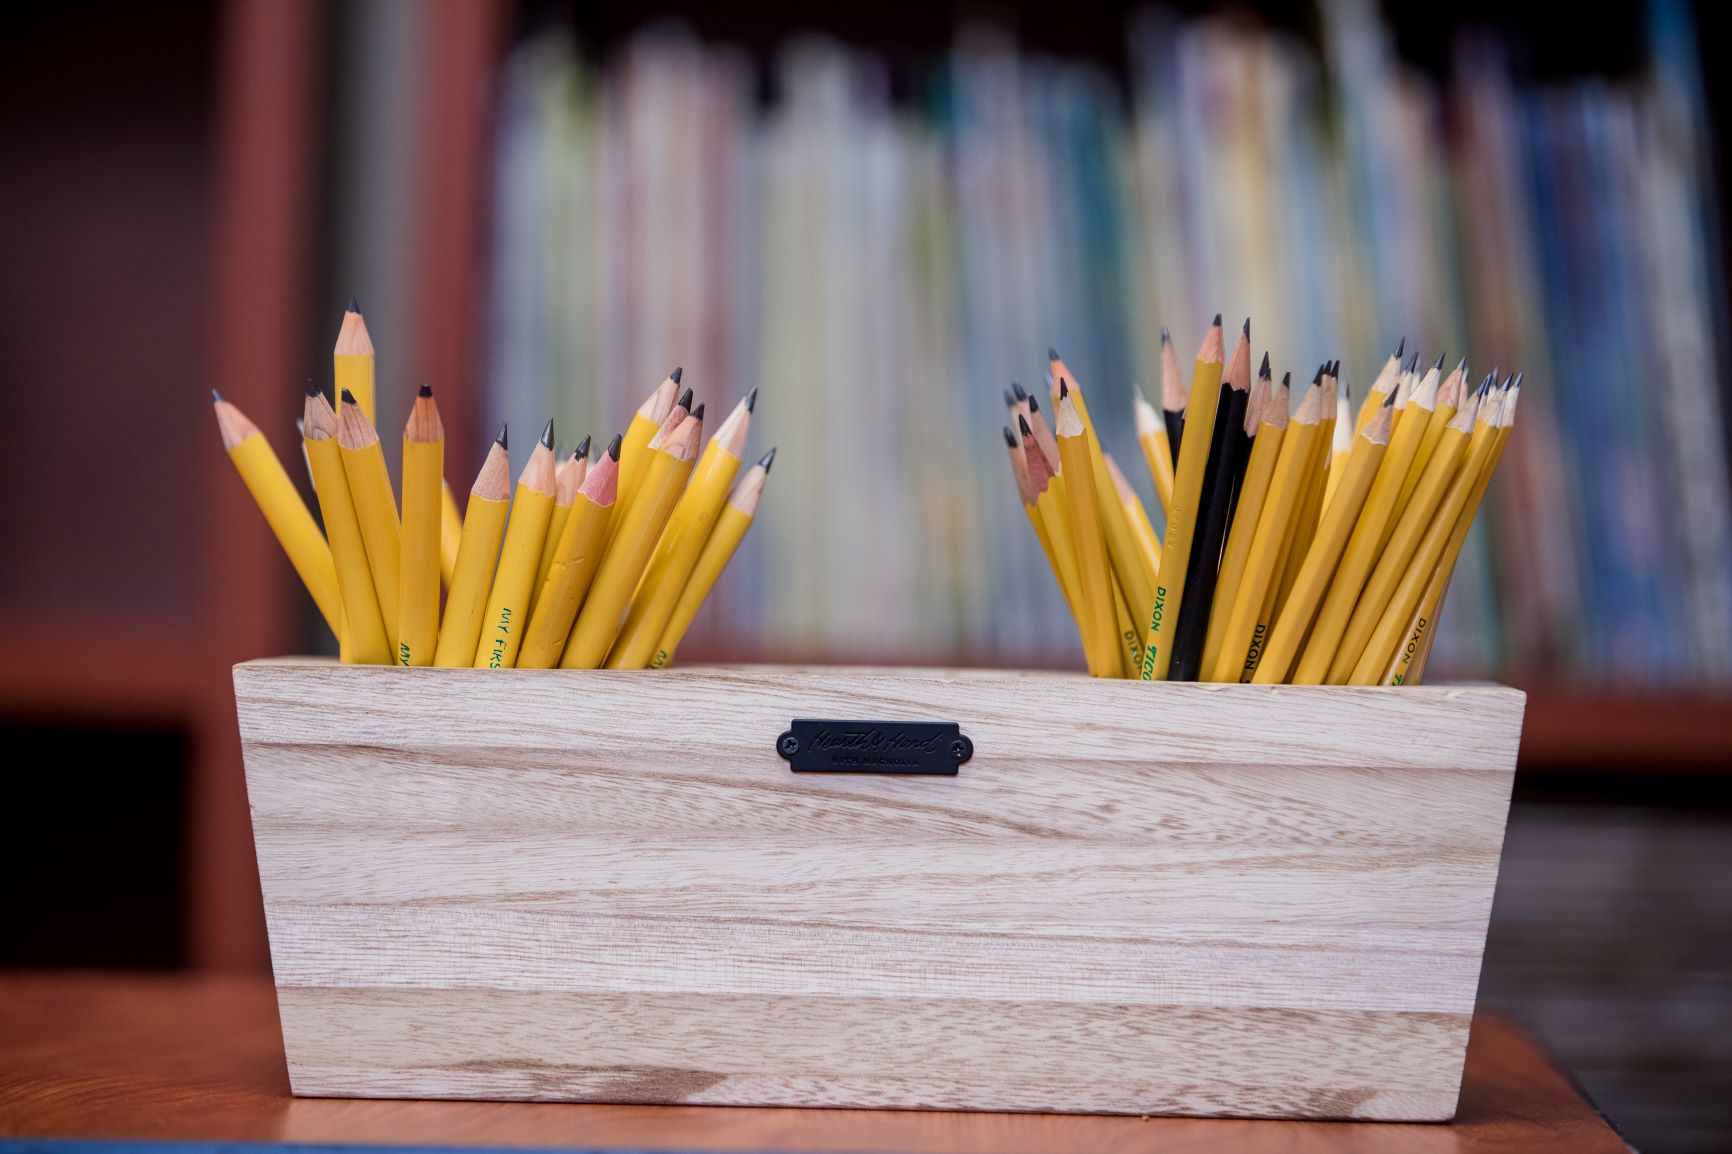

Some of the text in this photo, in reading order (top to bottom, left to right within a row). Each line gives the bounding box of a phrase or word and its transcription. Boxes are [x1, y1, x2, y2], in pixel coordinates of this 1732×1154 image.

[1152, 586, 1167, 632] DIXON
[400, 642, 411, 667] MY
[1245, 624, 1266, 670] DIXON
[1402, 617, 1427, 665] DIXON
[808, 727, 877, 753] Hearth
[883, 731, 943, 755] Hand
